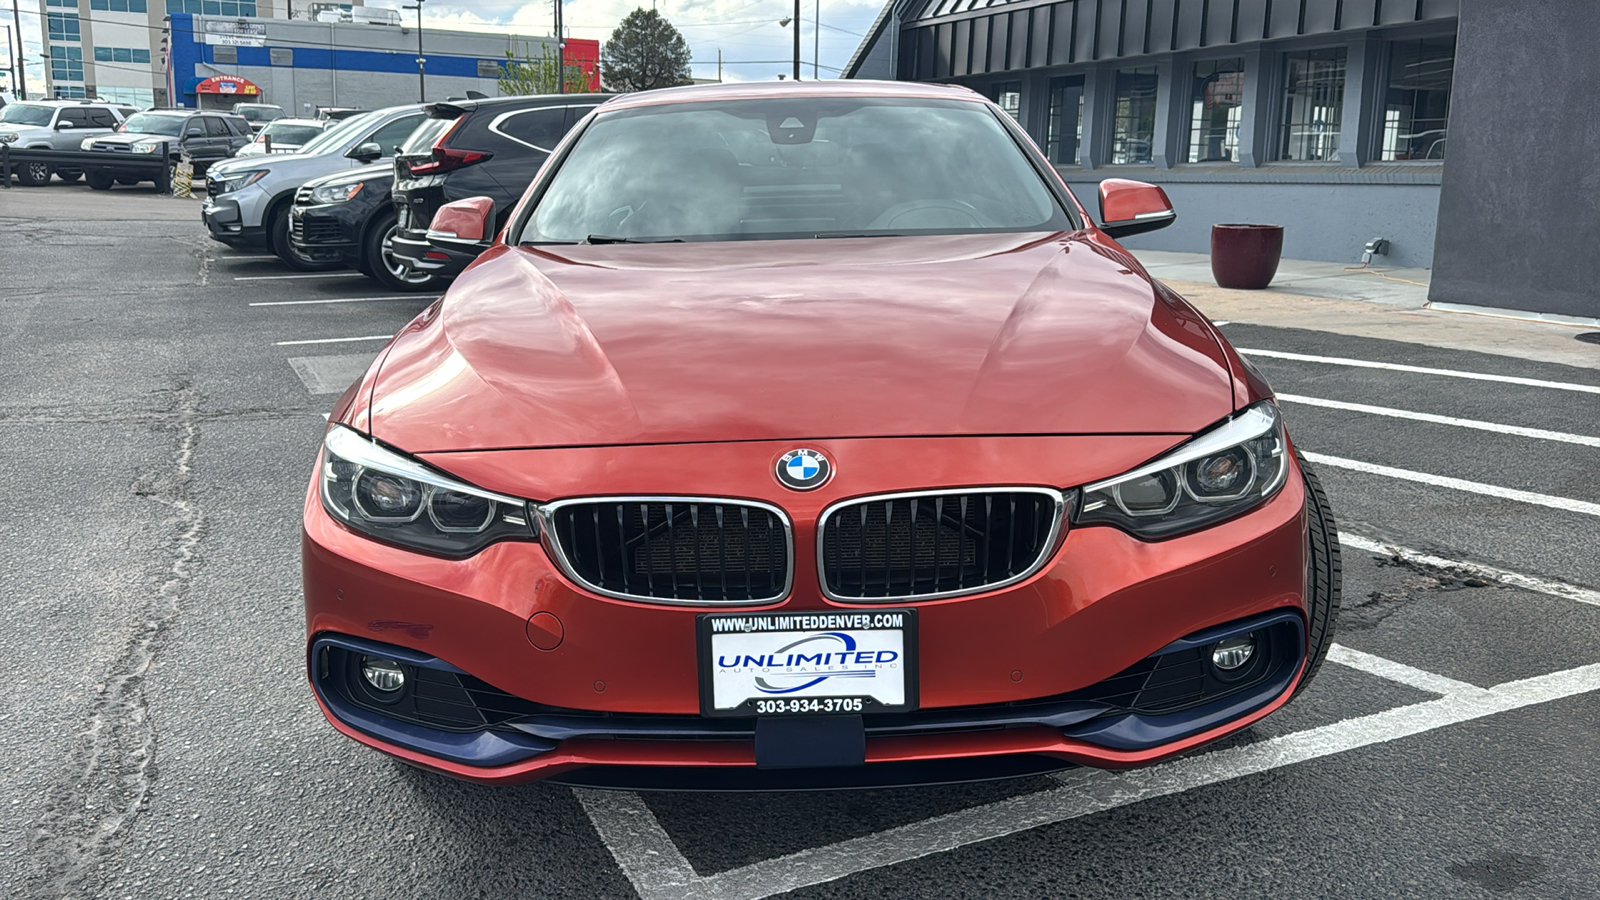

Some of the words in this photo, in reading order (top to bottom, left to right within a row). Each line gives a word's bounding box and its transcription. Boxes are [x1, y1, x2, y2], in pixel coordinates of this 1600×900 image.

[211, 75, 245, 84] ENTRANCE
[782, 449, 825, 461] BMW
[712, 614, 903, 632] WWWUNLIMITEDDENVER.COM
[718, 650, 898, 667] UNLIMITED
[786, 665, 849, 673] SALES
[756, 698, 862, 714] 303-934-3705
